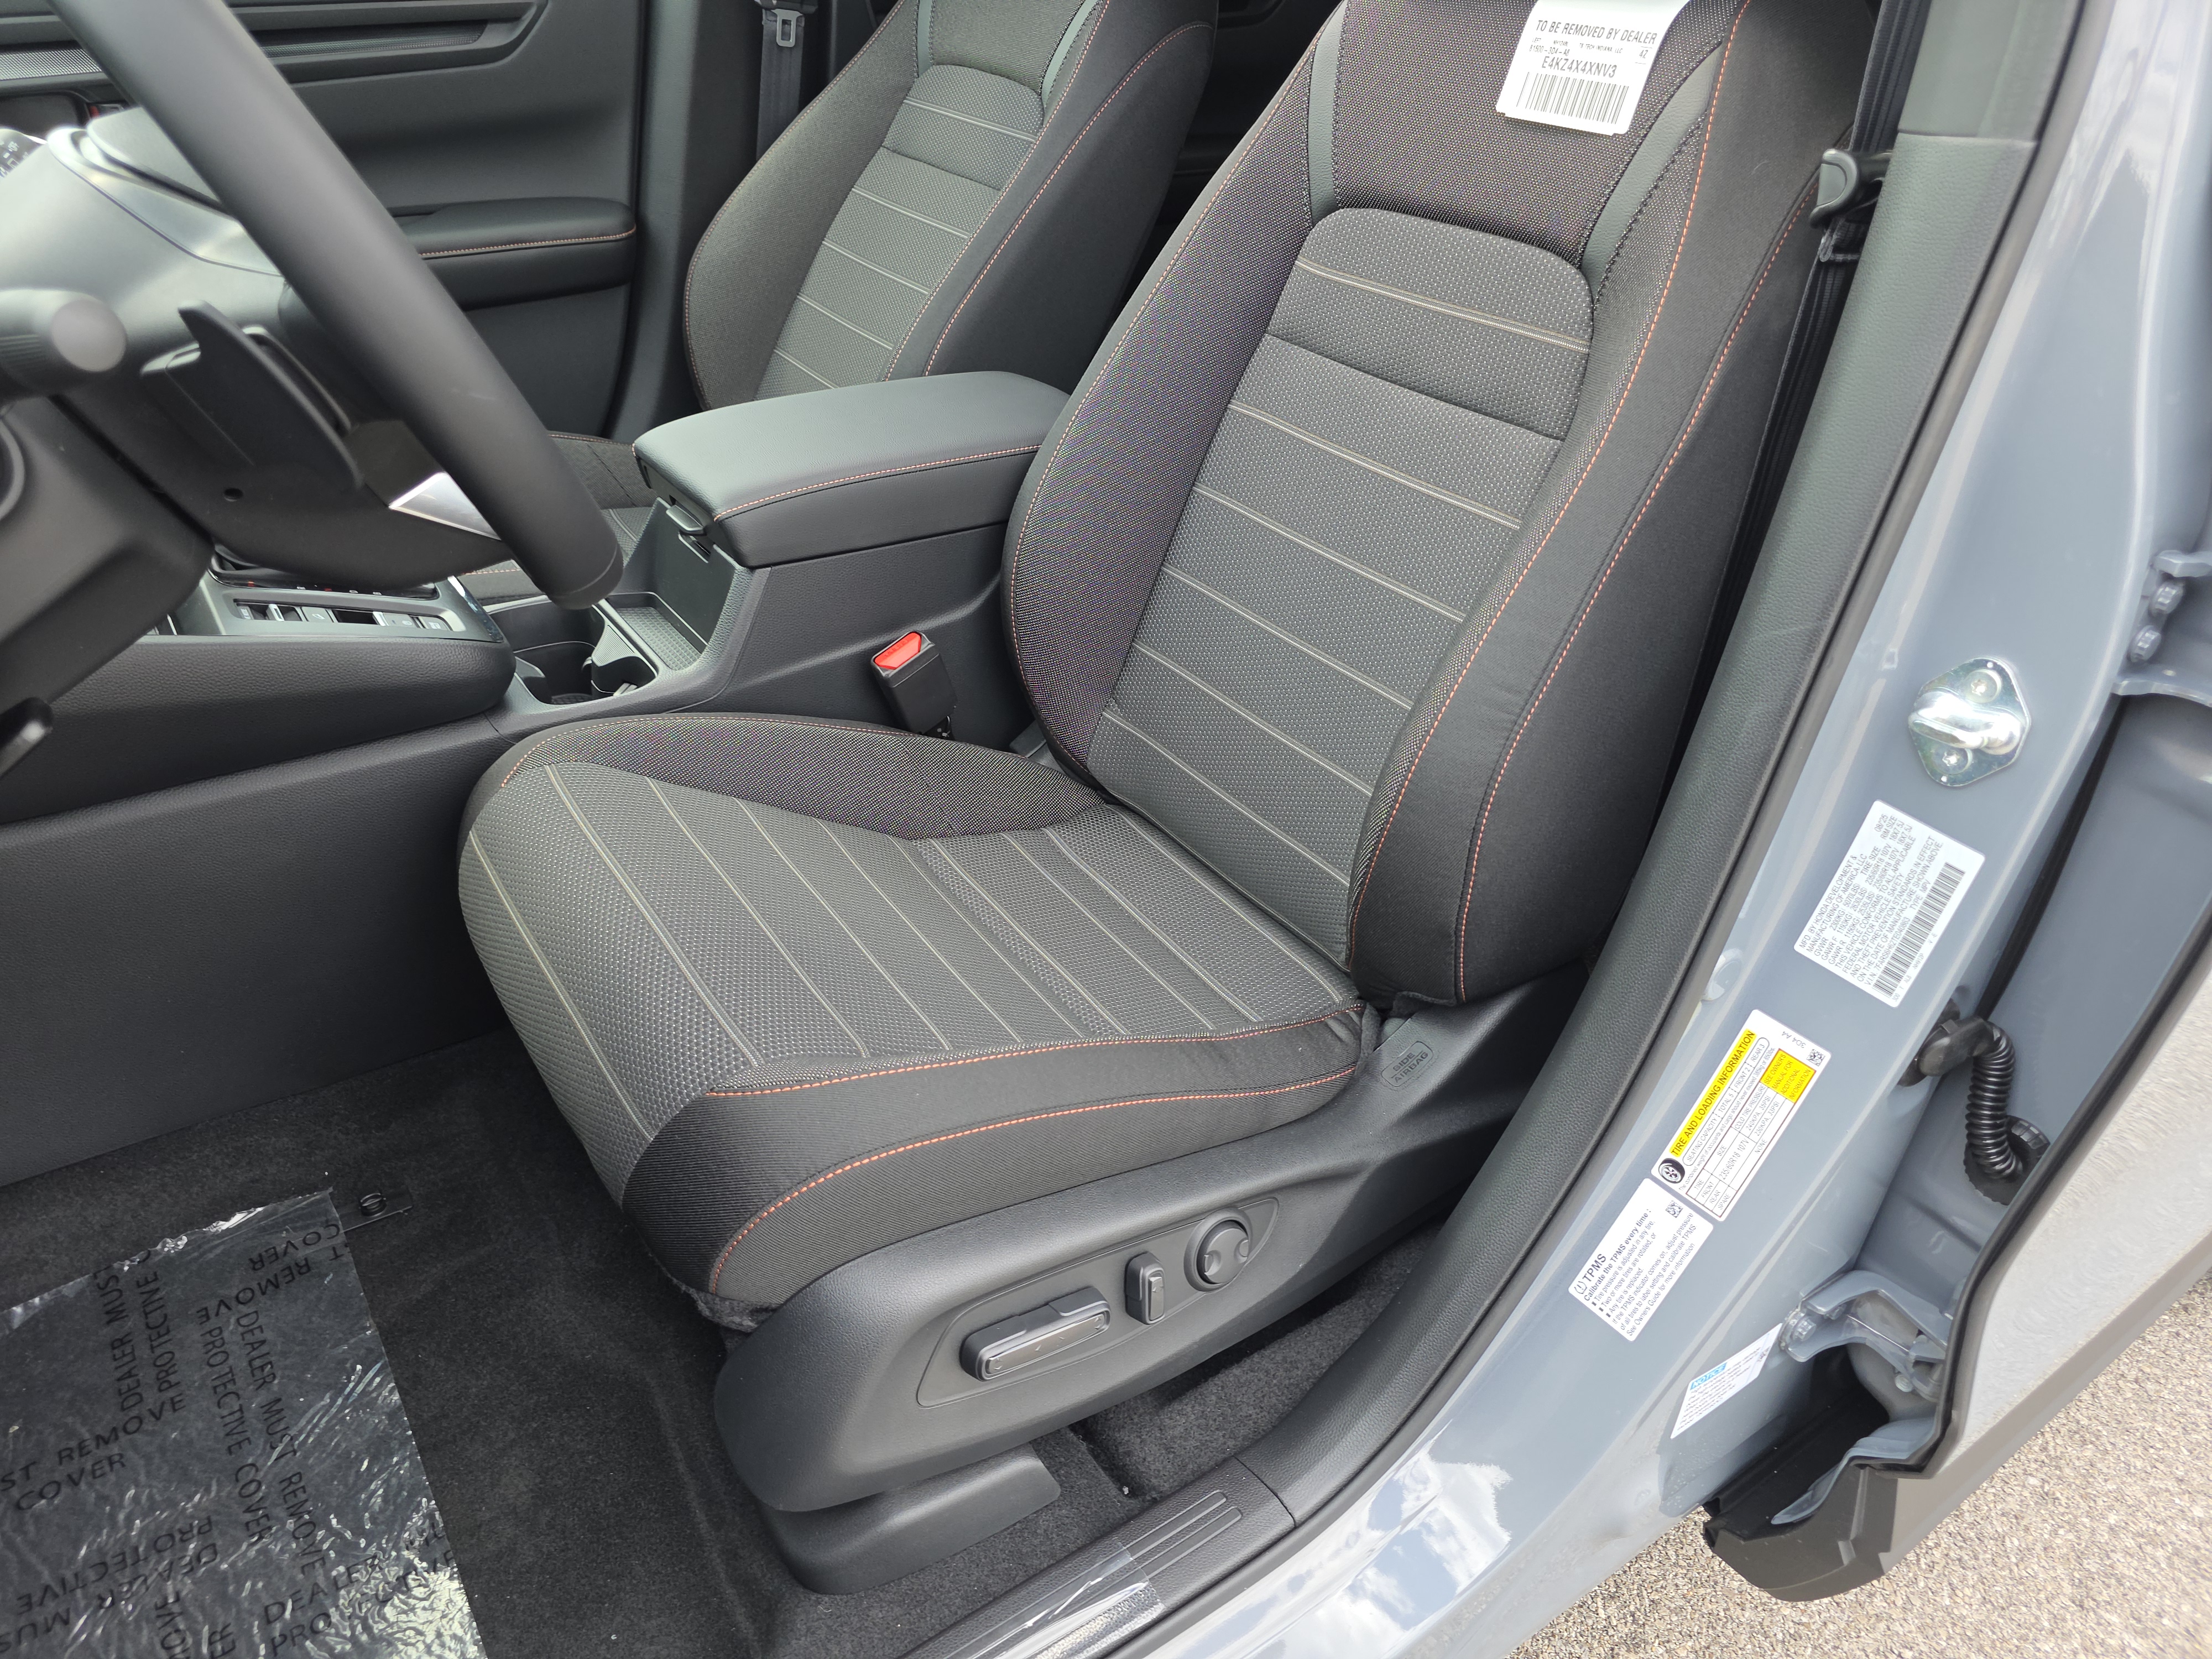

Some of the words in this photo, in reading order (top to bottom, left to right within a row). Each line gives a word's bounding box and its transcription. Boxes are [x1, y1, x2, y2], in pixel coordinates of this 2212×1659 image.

[1536, 20, 1548, 32] TO
[1548, 21, 1562, 33] BE
[1562, 23, 1605, 38] REMOVED
[1605, 28, 1621, 40] BY
[1620, 29, 1657, 44] DEALER
[1542, 56, 1617, 78] E4KZ4X4XNV3
[1880, 828, 1891, 840] RIM
[1886, 815, 1898, 829] SIZE
[1860, 860, 1873, 875] TIRE
[1868, 846, 1881, 862] SIZE
[1865, 857, 1885, 885] 235/60R18
[1880, 843, 1892, 857] 107V
[1872, 862, 1892, 889] 235/60R18
[1887, 847, 1900, 862] 107V
[1806, 903, 1839, 952] MANUFACTURING
[1835, 893, 1844, 903] OF
[1855, 853, 1867, 867] LLC
[1808, 924, 1817, 934] BY
[1813, 904, 1830, 925] HONDA
[1825, 859, 1854, 904] DEVELOPMENT
[1834, 954, 1848, 968] THIS
[1843, 928, 1864, 954] VEHICLE
[1859, 894, 1884, 929] CONFORMS
[1878, 884, 1889, 894] TO
[1884, 874, 1896, 886] ALL
[1891, 835, 1916, 874] APPLICABLE
[1918, 879, 1931, 894] MPV
[1842, 947, 1863, 973] FEDERAL
[1858, 923, 1876, 946] MOTOR
[1871, 896, 1892, 923] VEHICLE
[1887, 873, 1905, 898] SAFETY
[1850, 964, 1862, 978] AND
[1857, 943, 1873, 964] THEFT
[1869, 905, 1896, 945] PREVENTION
[1892, 869, 1917, 906] STANDARDS
[1912, 860, 1922, 869] IN
[1917, 836, 1935, 862] EFFECT
[1856, 971, 1867, 982] ON
[1862, 958, 1875, 972] THE
[1870, 942, 1885, 959] DATE
[1880, 932, 1889, 943] OF
[1886, 888, 1917, 933] MANUFACTURE
[1912, 863, 1931, 888] SHOWN
[1814, 937, 1829, 956] GVWR
[1821, 941, 1836, 961] GAWR
[1828, 946, 1843, 964] GAWR
[1750, 1045, 1764, 1062] REAR
[1781, 1031, 1792, 1039] A4
[1792, 1037, 1806, 1048] 3D4
[1392, 1052, 1416, 1072] SIDE
[1394, 1051, 1429, 1084] AIRBAG
[1734, 1071, 1747, 1088] FRONT
[1764, 1073, 1773, 1084] SEE
[1771, 1071, 1787, 1090] MANUAL
[1783, 1060, 1793, 1072] FOR
[1671, 1137, 1687, 1155] TIRE
[1684, 1120, 1698, 1139] AND
[1694, 1085, 1721, 1120] LOADING
[1717, 1031, 1755, 1085] INFORMATION
[1780, 1069, 1801, 1095] ADDITIONAL
[1788, 1068, 1811, 1100] INFORMATION
[1718, 1098, 1731, 1113] TOTAL
[1734, 1117, 1745, 1129] COLD
[1741, 1107, 1752, 1117] TIRE
[1748, 1084, 1766, 1108] PRESSURE
[1687, 1140, 1703, 1162] SEATING
[1700, 1118, 1717, 1141] CAPACITY
[1717, 1145, 1727, 1156] SIZE
[1754, 1139, 1767, 1154] NONE
[1719, 1151, 1741, 1180] 235/60R18
[1737, 1138, 1749, 1152] 107V
[1694, 1178, 1704, 1190] TIRE
[1701, 1181, 1714, 1198] FRONT
[1709, 1190, 1721, 1204] REAR
[1718, 1193, 1731, 1210] SPARE
[249, 1223, 340, 1271] COVER
[1584, 1274, 1605, 1301] Calibrate
[1603, 1263, 1613, 1274] the
[1610, 1244, 1626, 1262] TPMS
[1624, 1227, 1639, 1245] every
[1635, 1213, 1648, 1227] time
[1593, 1291, 1604, 1301] Tire
[1602, 1270, 1619, 1293] pressure
[1621, 1244, 1637, 1266] adjusted
[1639, 1229, 1648, 1240] any
[1582, 1254, 1606, 1282] TPMS
[1600, 1296, 1612, 1307] Two
[1614, 1277, 1625, 1291] more
[1622, 1266, 1633, 1278] tires
[1631, 1258, 1640, 1267] are
[1615, 1311, 1624, 1321] the
[1620, 1295, 1635, 1311] TPMS
[1633, 1275, 1649, 1296] indicator
[1647, 1258, 1662, 1275] comes
[1665, 1234, 1679, 1250] adjust
[1676, 1213, 1693, 1236] pressure
[1640, 1288, 1651, 1302] label
[1661, 1261, 1671, 1272] and
[1668, 1241, 1685, 1262] calibrate
[196, 1257, 312, 1326] REMOVE
[1609, 1303, 1619, 1314] Any
[1615, 1295, 1625, 1303] tire
[1626, 1325, 1637, 1336] See
[1647, 1291, 1661, 1306] Guide
[1664, 1270, 1676, 1284] more
[136, 1271, 181, 1394] PROTECTIVE
[111, 1331, 144, 1412] DEALER
[57, 1392, 187, 1466] REMOVE
[200, 1326, 252, 1456] PROTECTIVE
[234, 1463, 274, 1546] COVER
[236, 1310, 278, 1391] DEALER
[260, 1397, 298, 1462] MUST
[279, 1471, 327, 1577] REMOVE
[17, 1452, 127, 1510] COVER
[16, 1515, 213, 1616] PROTECTIVE
